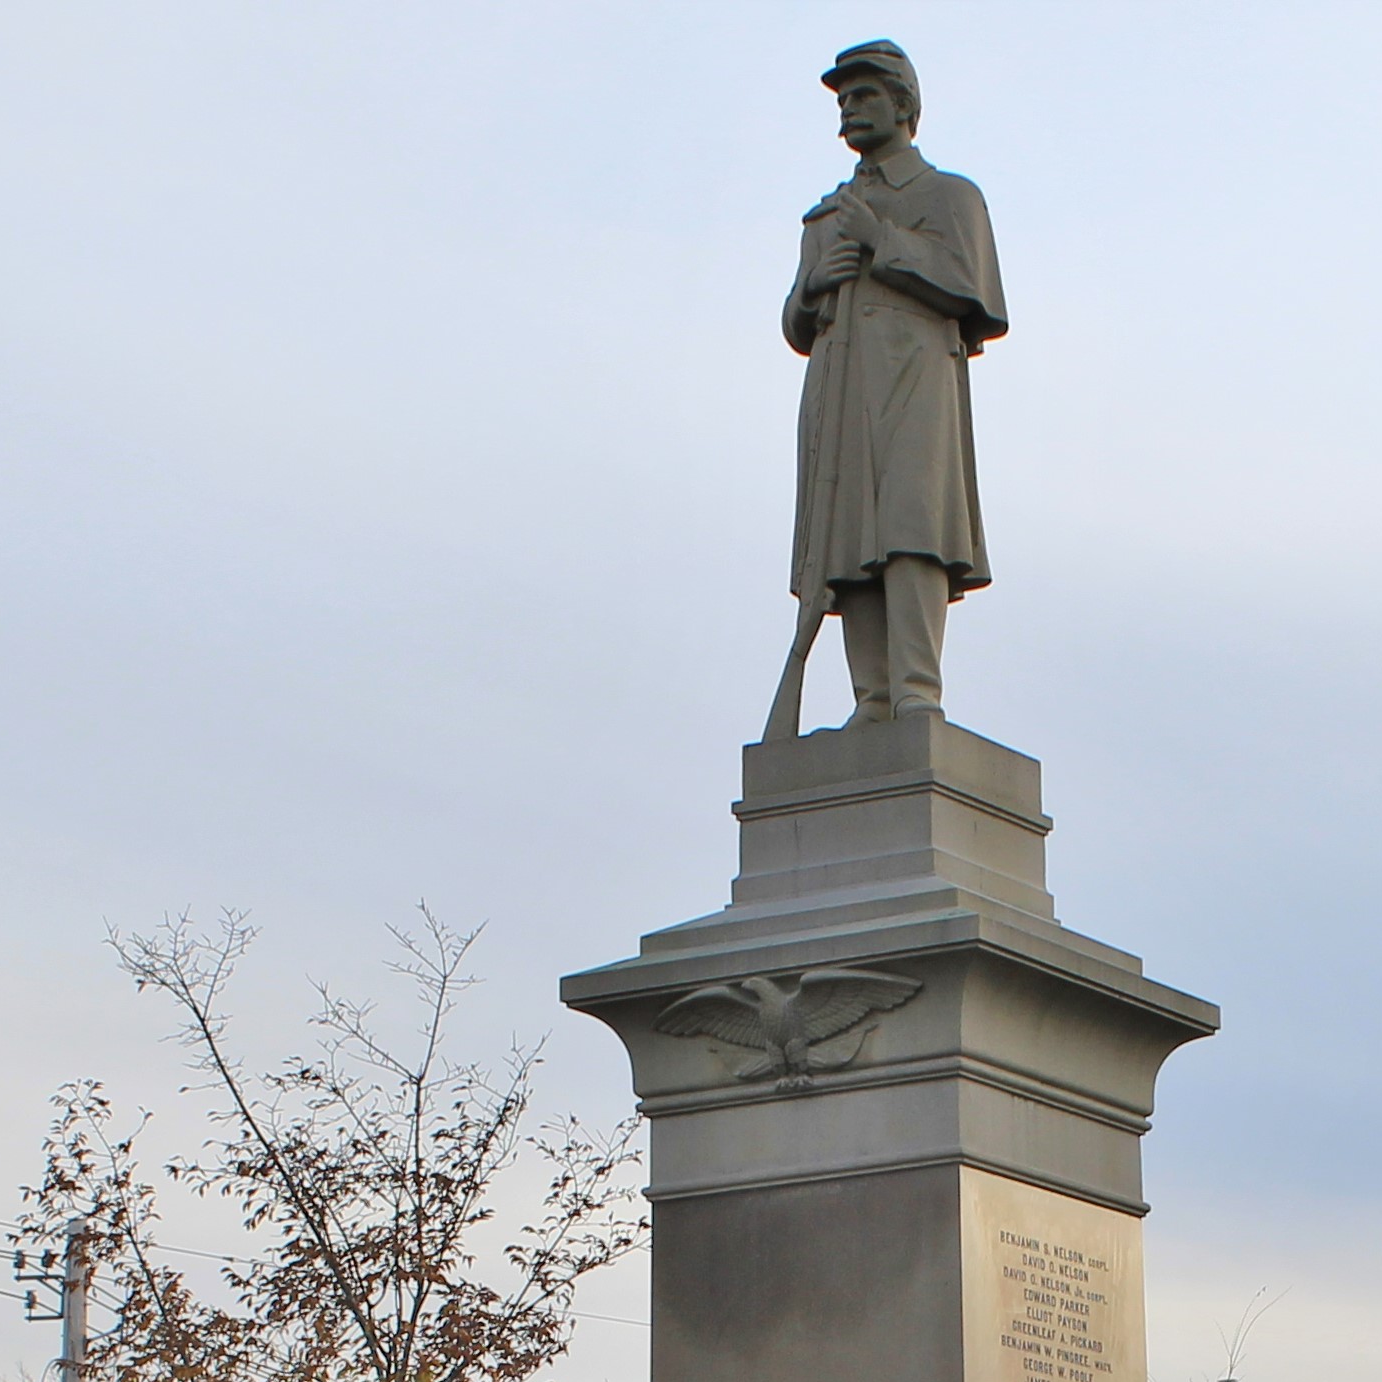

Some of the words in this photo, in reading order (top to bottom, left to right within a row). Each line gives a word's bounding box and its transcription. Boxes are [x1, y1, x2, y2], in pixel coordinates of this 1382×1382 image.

[1000, 1230, 1040, 1252] BENJAMIN
[1003, 1266, 1027, 1282] DAVID
[1022, 1254, 1046, 1271] DAVID
[1059, 1264, 1089, 1282] NELSON
[1024, 1288, 1056, 1307] EDWARD
[1060, 1298, 1090, 1316] PARKER
[1027, 1306, 1052, 1324] ELLIOT
[1057, 1314, 1087, 1332] PAYSON
[1001, 1335, 1041, 1355] BENJAMIN
[1012, 1320, 1056, 1340] GREENLEAF
[1070, 1335, 1103, 1353] PICKARD
[1023, 1358, 1053, 1376] GEORGE
